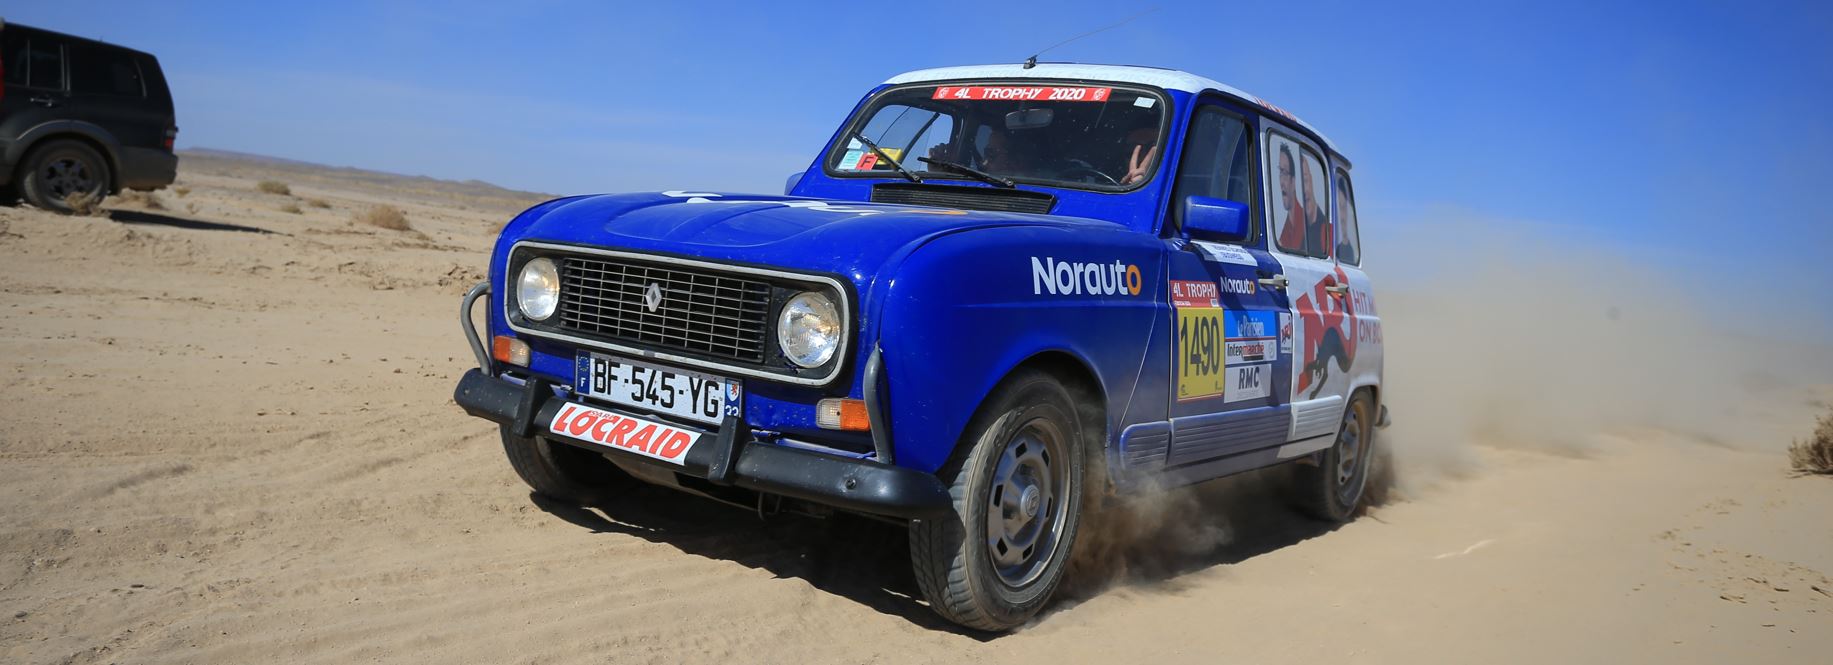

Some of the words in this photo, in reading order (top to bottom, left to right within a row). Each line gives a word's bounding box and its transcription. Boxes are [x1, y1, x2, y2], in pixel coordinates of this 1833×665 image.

[954, 88, 971, 99] 4L
[982, 88, 1043, 100] TROPHY
[1050, 88, 1086, 100] 2020
[1031, 256, 1142, 295] Norauto
[1220, 276, 1255, 295] Norauto
[1173, 283, 1184, 298] 4L
[1186, 283, 1217, 299] TROPHY
[1180, 316, 1220, 378] 1490
[1238, 366, 1260, 390] RMC
[552, 406, 691, 460] LOCRAID
